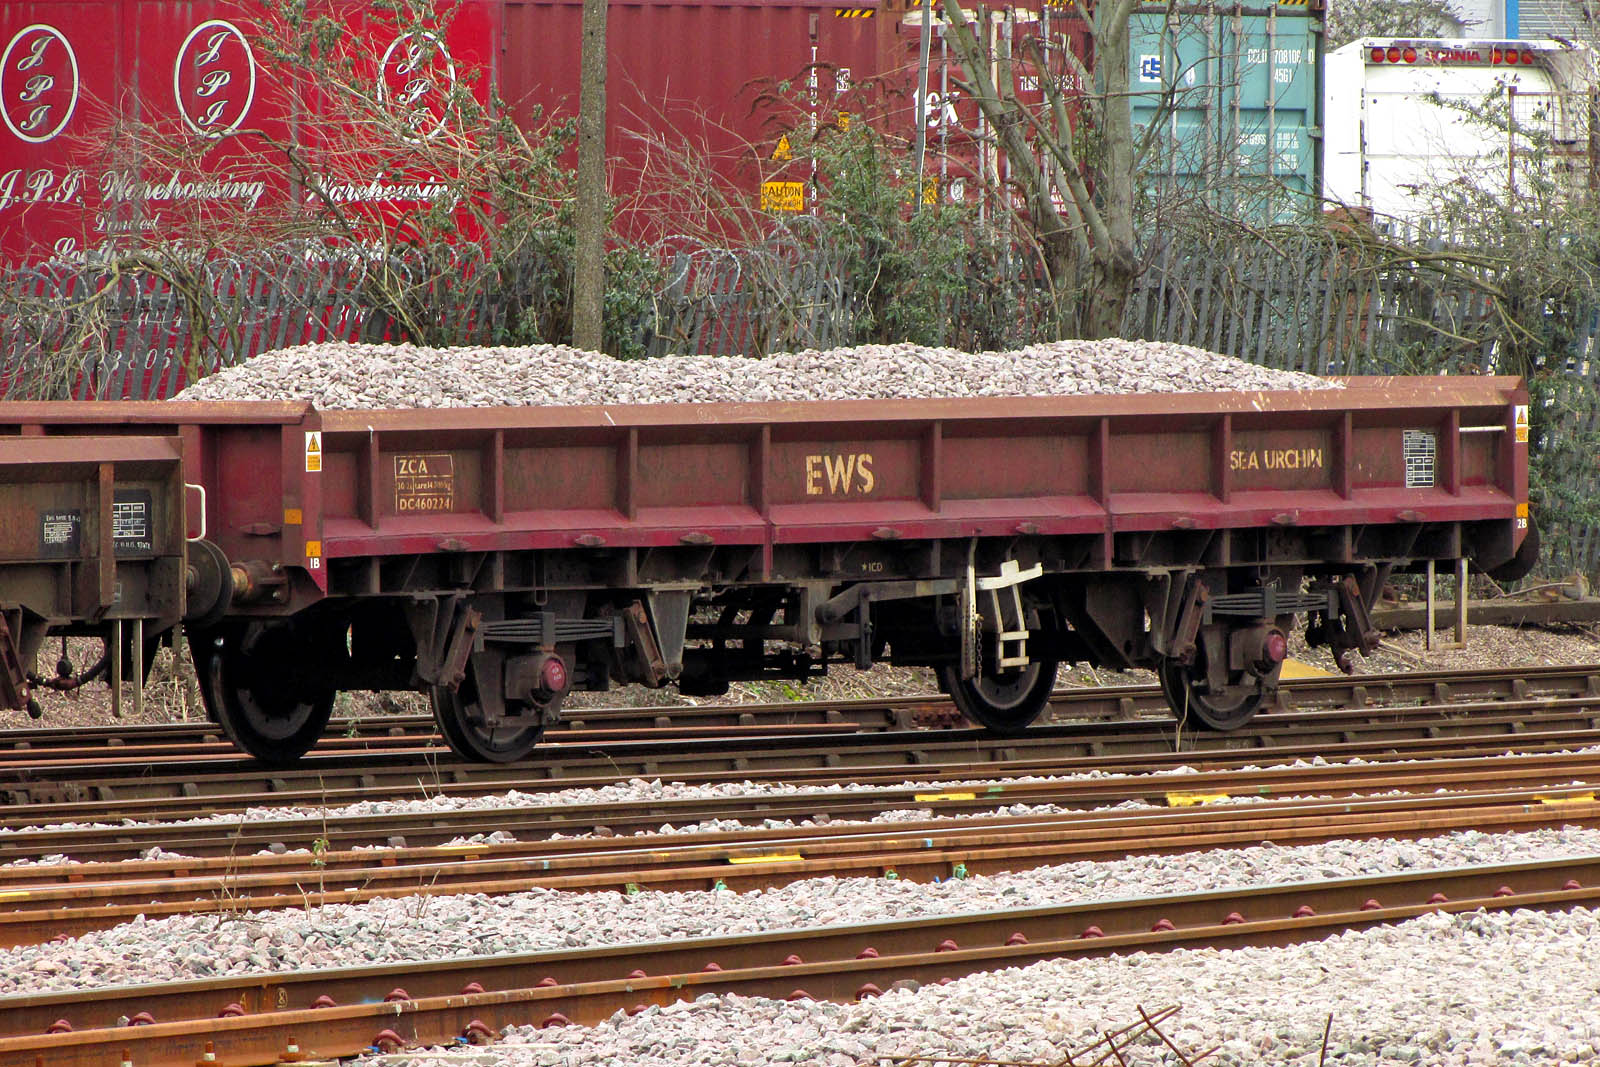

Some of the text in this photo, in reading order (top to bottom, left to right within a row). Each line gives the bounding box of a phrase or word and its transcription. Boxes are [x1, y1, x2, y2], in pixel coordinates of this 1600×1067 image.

[1424, 50, 1480, 62] SCANIA
[1274, 68, 1293, 82] 45G1
[399, 459, 428, 474] ZCA
[1230, 449, 1323, 470] SEA URCHIN
[806, 454, 875, 495] EWS
[399, 497, 450, 511] DC460224
